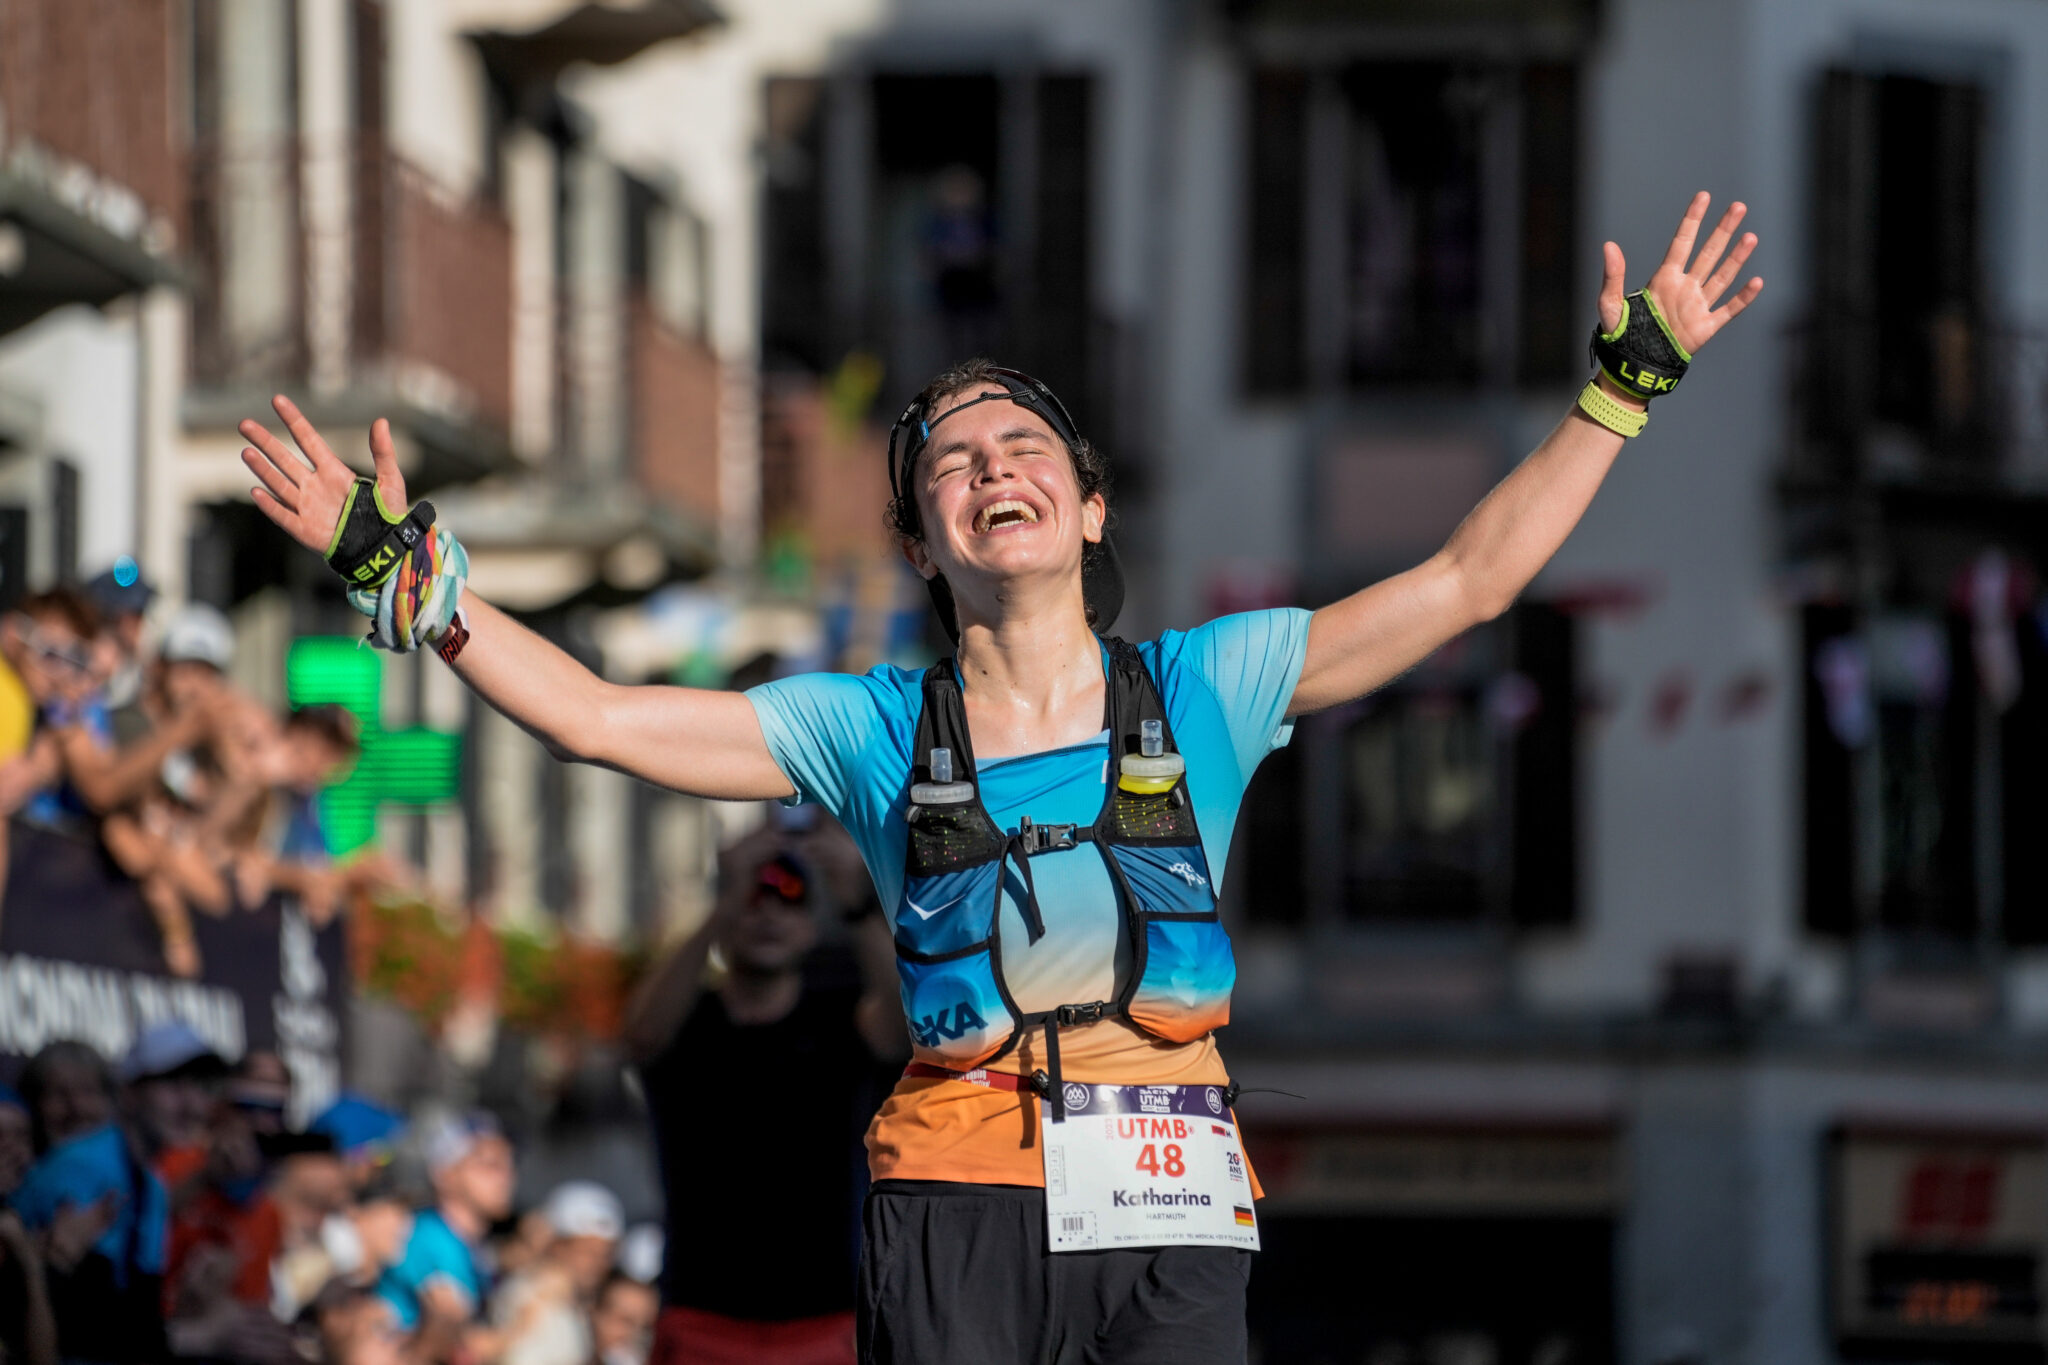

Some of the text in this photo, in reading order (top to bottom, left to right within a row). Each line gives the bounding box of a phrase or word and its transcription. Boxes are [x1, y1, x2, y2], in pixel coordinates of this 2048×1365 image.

[1619, 361, 1678, 392] LEKI
[353, 545, 396, 582] EKI
[1140, 1095, 1170, 1106] UTMB
[1135, 1143, 1186, 1178] 48
[1113, 1187, 1212, 1207] Katharina
[1146, 1213, 1186, 1221] HARTMUTH
